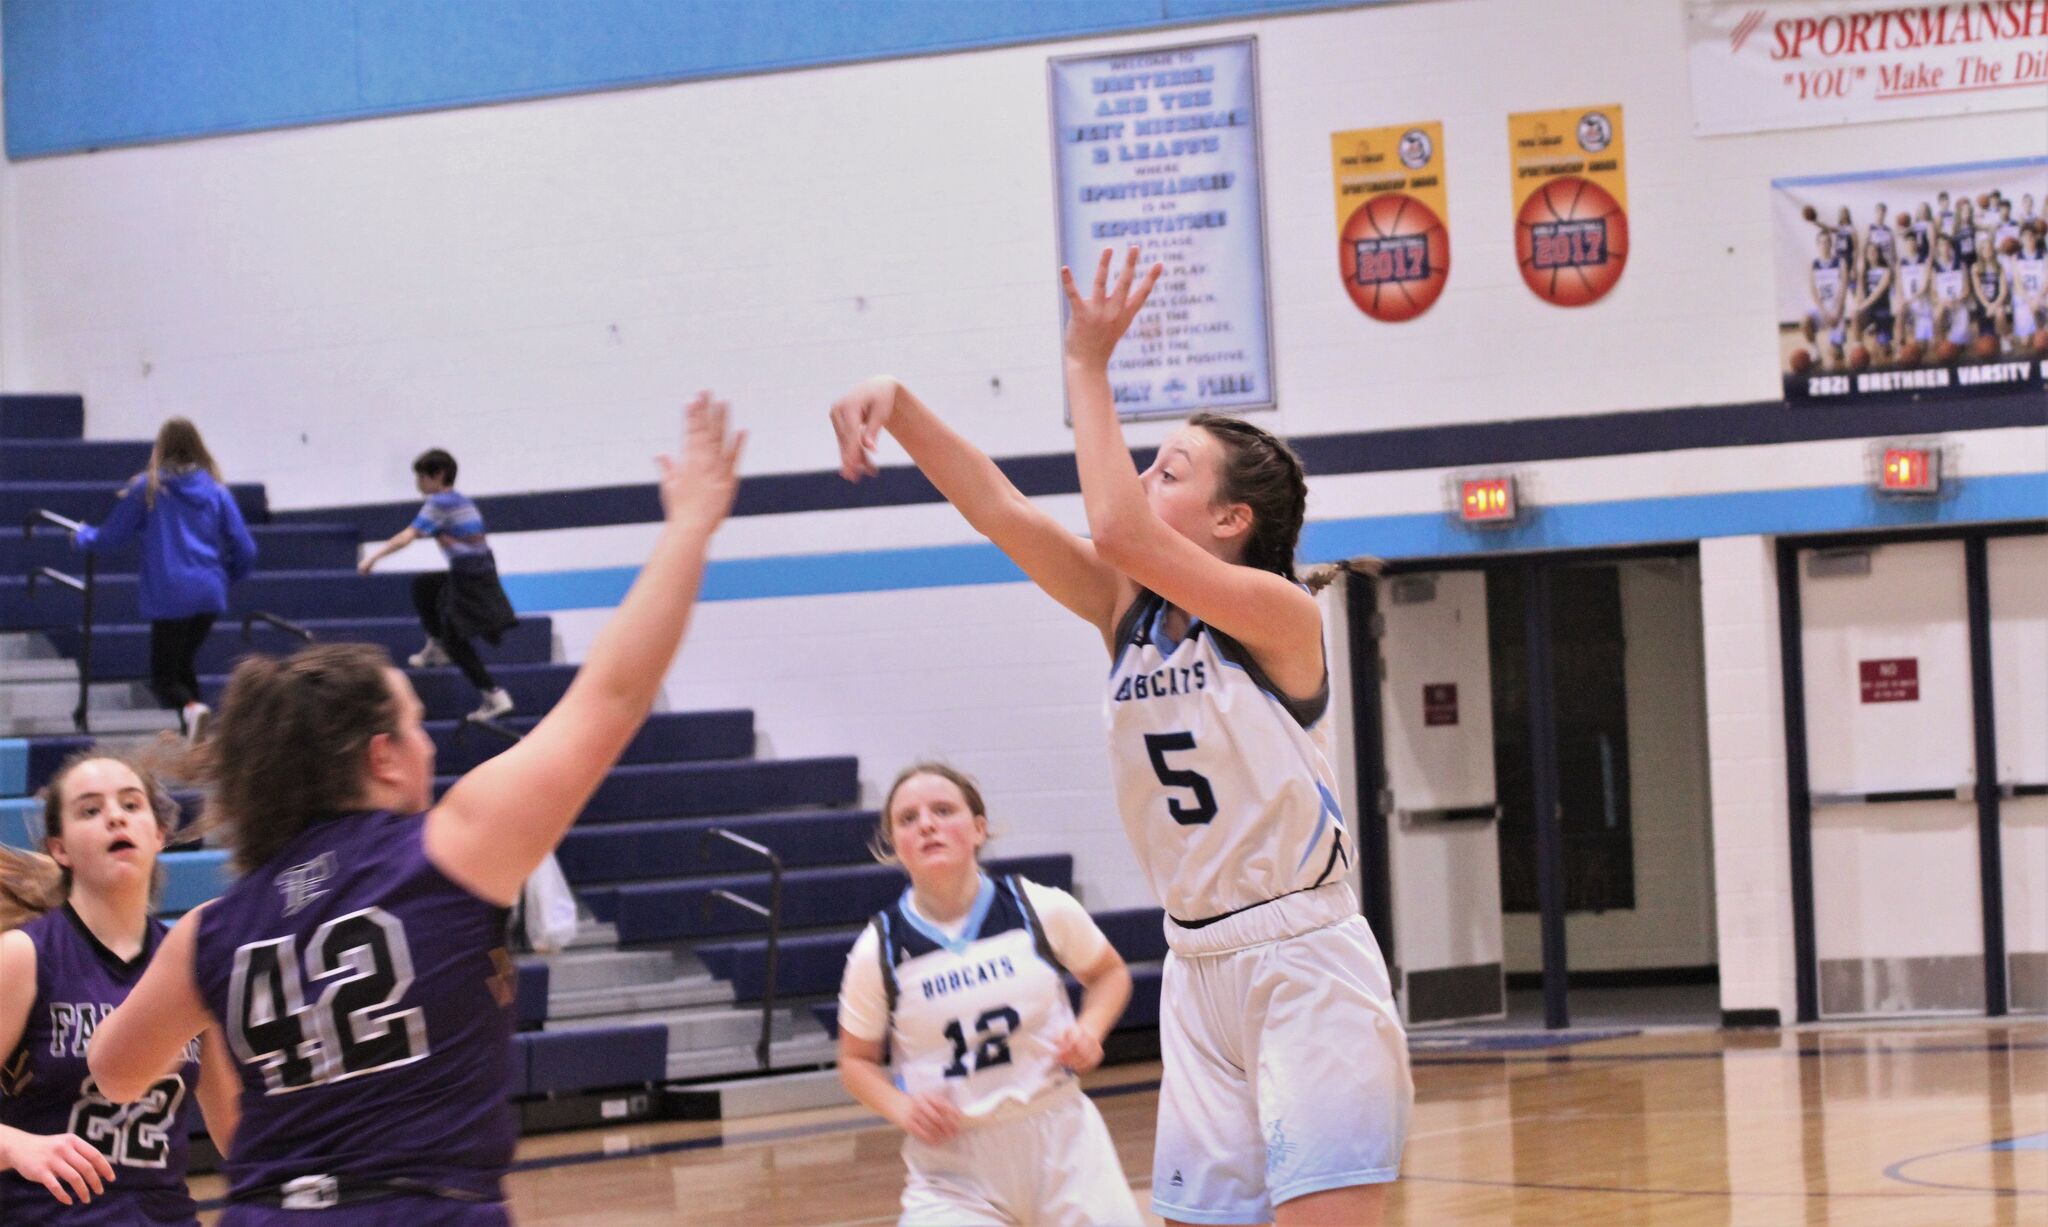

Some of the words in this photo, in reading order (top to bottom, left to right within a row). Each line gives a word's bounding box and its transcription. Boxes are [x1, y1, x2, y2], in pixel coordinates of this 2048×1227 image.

[1783, 66, 1867, 101] "YOU"
[1875, 63, 1944, 92] Make
[1957, 56, 2003, 85] The
[1359, 245, 1425, 280] 2017
[1535, 230, 1602, 265] 2017
[1957, 361, 2032, 386] VARSITY
[1143, 731, 1219, 825] 5
[226, 904, 431, 1097] 42
[943, 1005, 1021, 1079] 12
[66, 1072, 187, 1169] 22
